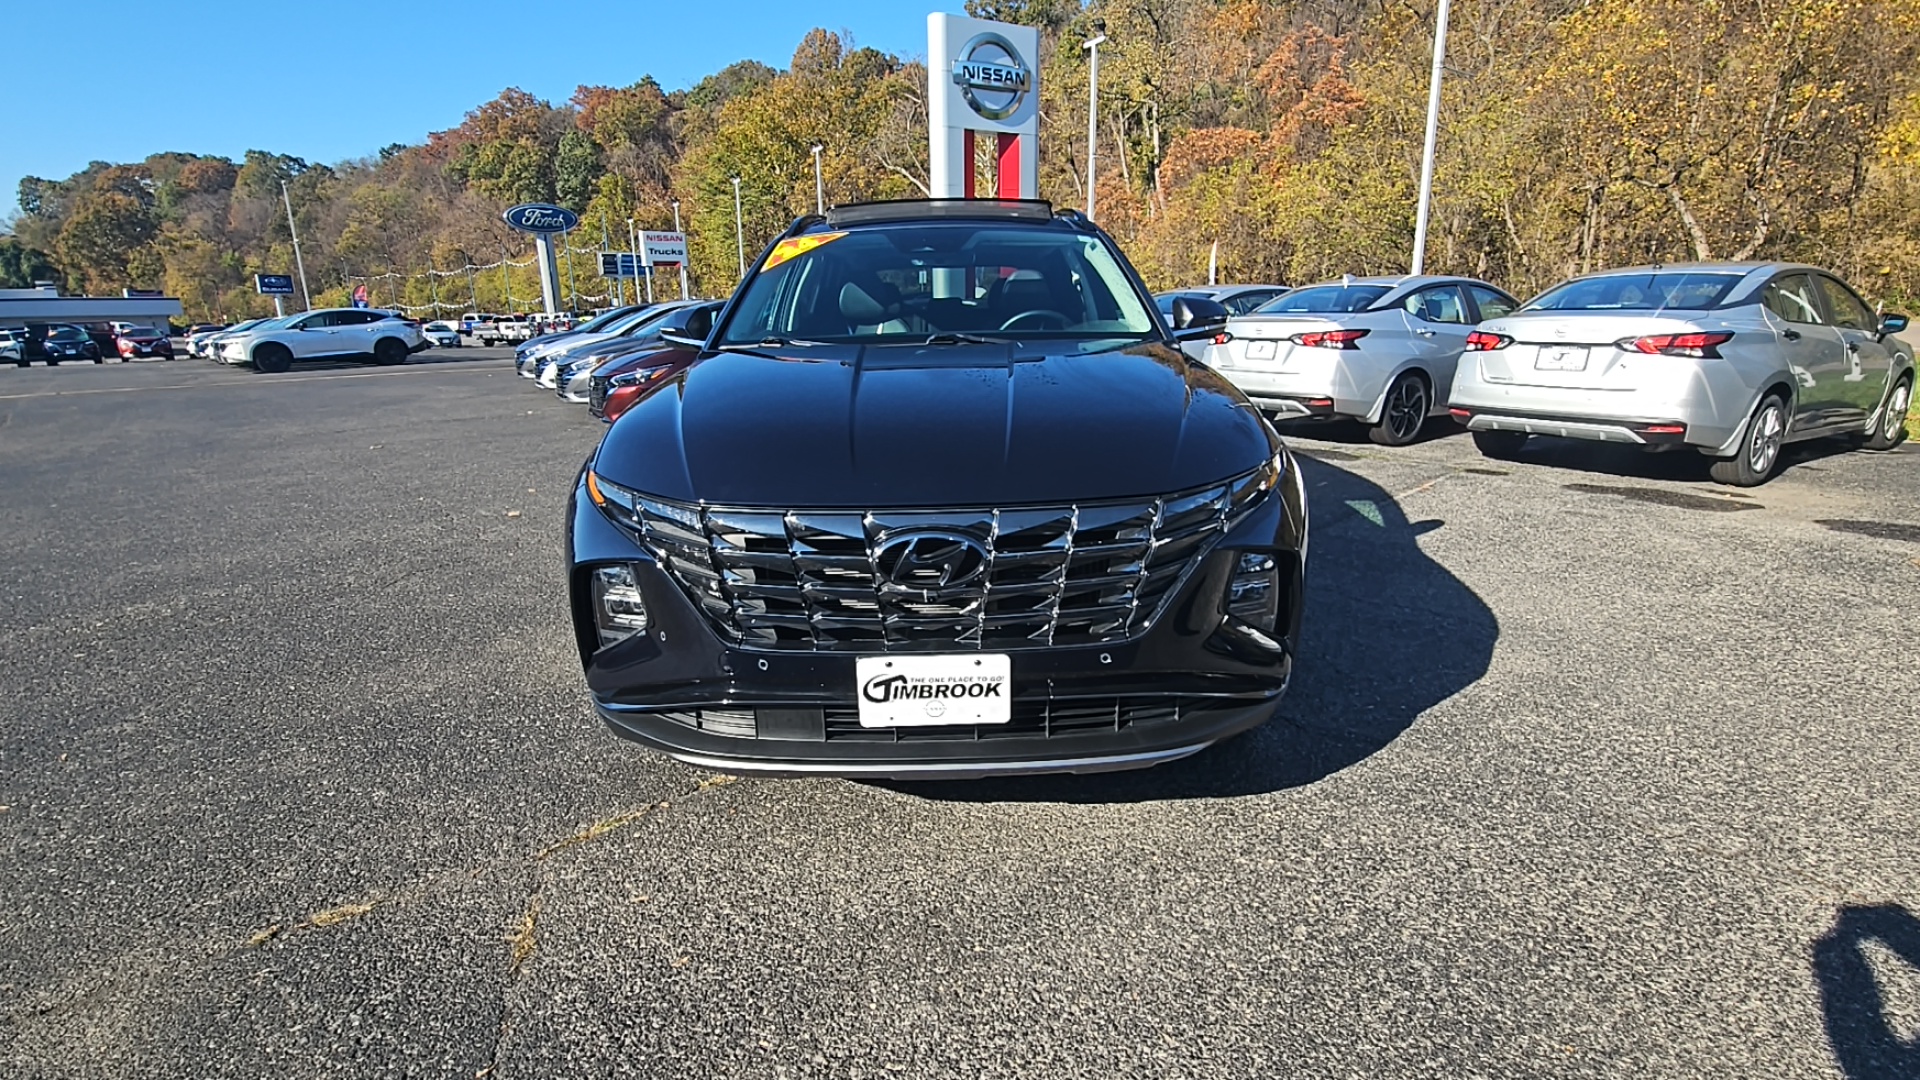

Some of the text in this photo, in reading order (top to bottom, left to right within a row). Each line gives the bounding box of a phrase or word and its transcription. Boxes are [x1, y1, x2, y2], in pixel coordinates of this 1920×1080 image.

[962, 65, 1025, 86] NISSAN
[521, 208, 564, 227] Ford
[646, 234, 683, 242] NISSAN
[648, 247, 684, 256] Trucks
